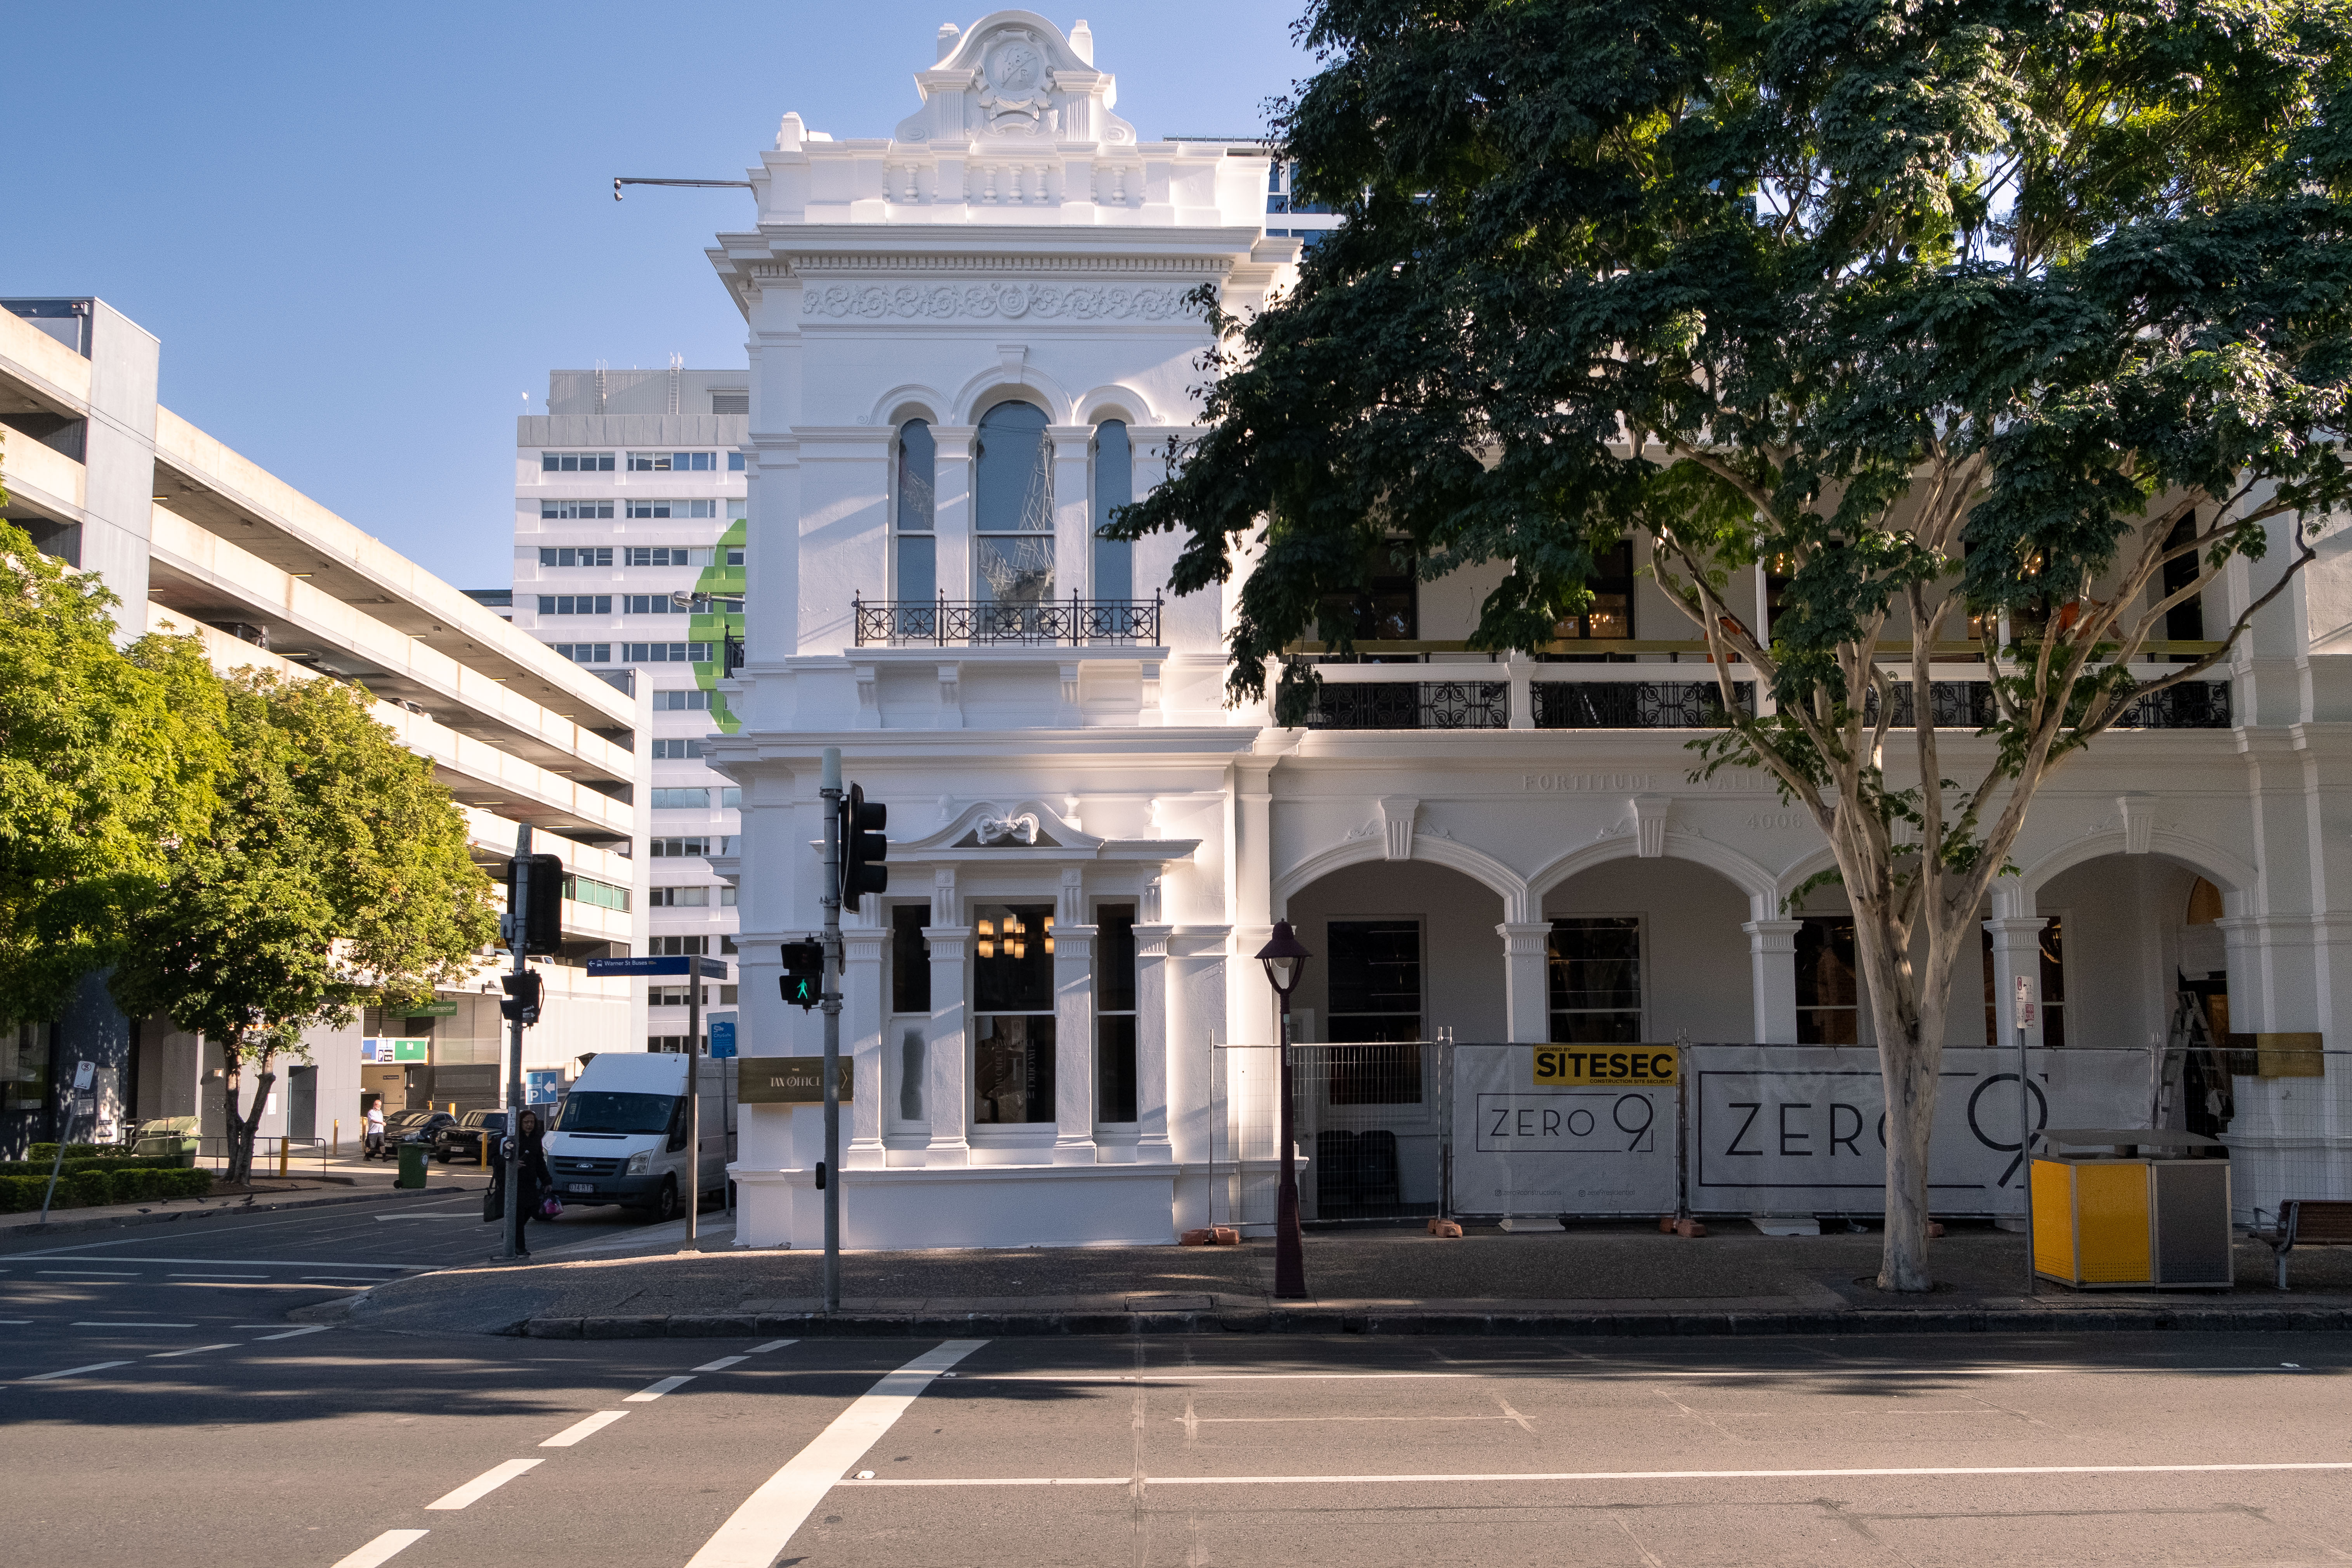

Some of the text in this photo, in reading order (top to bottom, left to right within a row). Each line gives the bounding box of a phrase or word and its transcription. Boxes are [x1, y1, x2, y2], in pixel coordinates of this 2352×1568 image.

[1522, 774, 1768, 790] FORTITUDE VALLE
[1746, 814, 1801, 829] 4006
[1537, 1053, 1673, 1078] SITESEC
[770, 1076, 822, 1087] TAX OFFICE
[530, 1090, 539, 1102] P
[1490, 1094, 1654, 1152] ZERO 9
[1967, 1073, 2048, 1188] 9
